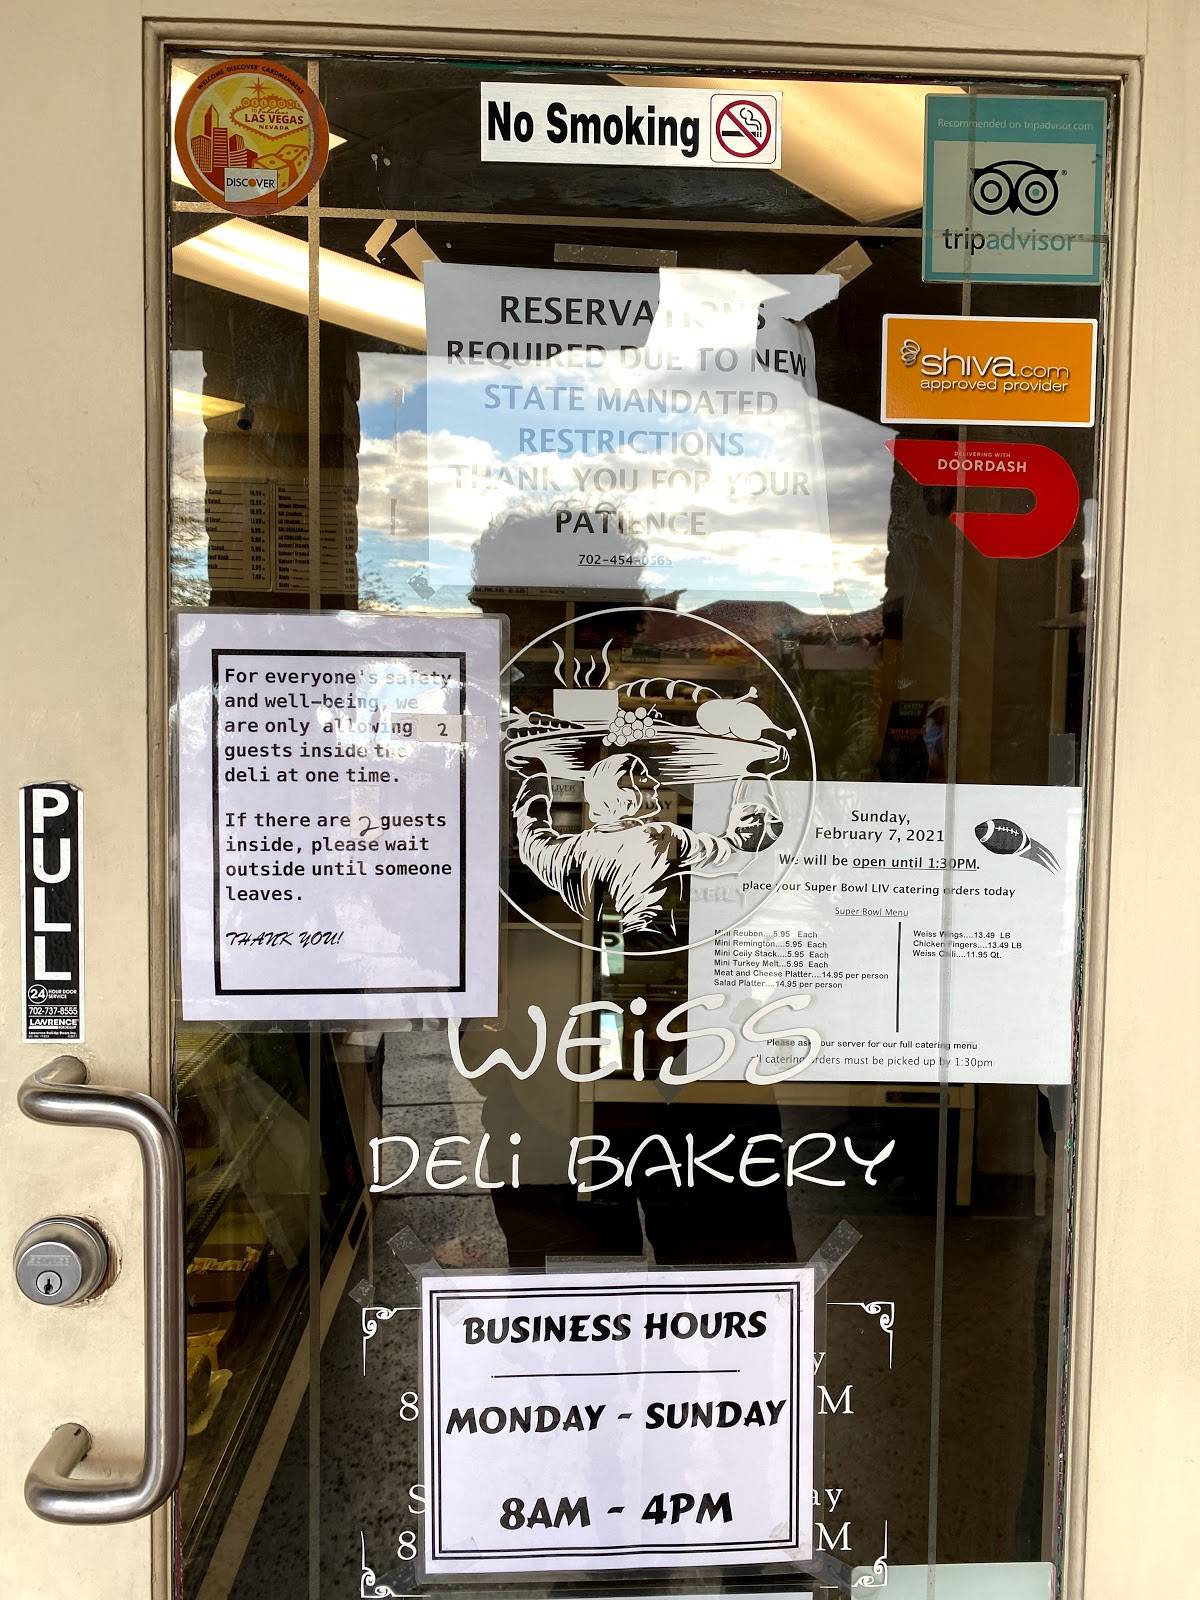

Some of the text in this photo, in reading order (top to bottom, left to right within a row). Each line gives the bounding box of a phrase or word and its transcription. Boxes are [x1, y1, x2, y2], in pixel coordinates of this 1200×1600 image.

[227, 64, 258, 73] DISCOVER
[262, 66, 305, 95] CARDMEMBERS
[245, 114, 304, 124] LAS VEGAS
[938, 118, 1093, 131] Recommended on tripadvisor.com
[488, 101, 700, 158] No Smoking
[226, 177, 275, 189] DISCOVER
[942, 228, 1075, 255] tripadvisor
[447, 340, 806, 377] REQUIRED DUE TO NEW
[921, 347, 1070, 379] shiva.com
[920, 378, 1069, 393] approved provider
[484, 384, 778, 416] STATE MANDATED
[518, 428, 744, 457] RESTRICTIONS
[938, 459, 1027, 473] DOORDASH
[447, 464, 811, 496] THANK YOU FOR YOUR
[555, 509, 706, 537] PATIENCE
[225, 668, 452, 689] For everyone's safety
[225, 693, 418, 712] and well-being, we
[225, 718, 448, 738] are only allowing 2
[224, 744, 292, 763] guests
[300, 742, 367, 758] inside
[225, 767, 400, 783] deli at one time.
[226, 812, 447, 837] If there are 2 guests
[851, 810, 910, 825] Sunday,
[815, 827, 944, 844] February 7, 2021
[226, 837, 429, 856] inside, please wait
[226, 860, 452, 877] outside until someone
[779, 853, 980, 870] We will be open until 1:30PM.
[32, 788, 72, 980] PULL
[742, 880, 1016, 898] place your Super Bowl LIV catering orders today
[226, 885, 302, 902] leaves.
[835, 907, 909, 917] Super Bowl Menu
[226, 931, 343, 948] THANK YOU!
[913, 930, 937, 938] Weiss
[714, 939, 731, 947] Mini
[807, 941, 828, 949] Each
[913, 940, 945, 948] Chicken
[714, 949, 731, 957] Mini
[809, 951, 829, 959] Each
[990, 951, 1002, 959] Qt.
[714, 959, 731, 967] Mini
[733, 959, 760, 969] Turkey
[808, 961, 829, 969] Each
[714, 969, 734, 977] Meat
[735, 969, 750, 977] and
[753, 969, 783, 978] Cheese
[845, 973, 859, 981] per
[861, 972, 889, 981] person
[714, 979, 736, 987] Salad
[799, 982, 812, 990] per
[815, 982, 843, 990] person
[30, 988, 46, 999] 24
[29, 1006, 78, 1015] 702-737-8555
[30, 1018, 77, 1026] LAWRENCE
[766, 1038, 795, 1047] Please
[819, 1039, 834, 1048] our
[837, 1040, 864, 1048] server
[868, 1040, 880, 1048] for
[882, 1041, 897, 1049] our
[899, 1040, 913, 1049] full
[915, 1041, 951, 1051] catering
[953, 1042, 978, 1050] menu
[765, 1055, 805, 1065] catering
[809, 1056, 840, 1065] rders
[844, 1056, 869, 1065] must
[872, 1056, 884, 1065] be
[887, 1056, 920, 1068] picked
[923, 1058, 935, 1068] up
[955, 1058, 993, 1068] 1:30pm
[567, 1131, 896, 1192] BAKERY
[463, 1310, 767, 1346] BUSINESS HOURS
[446, 1404, 606, 1435] MONDAY
[645, 1399, 787, 1430] SUNDAY
[500, 1496, 591, 1531] 8AM
[642, 1492, 734, 1525] 4PM
